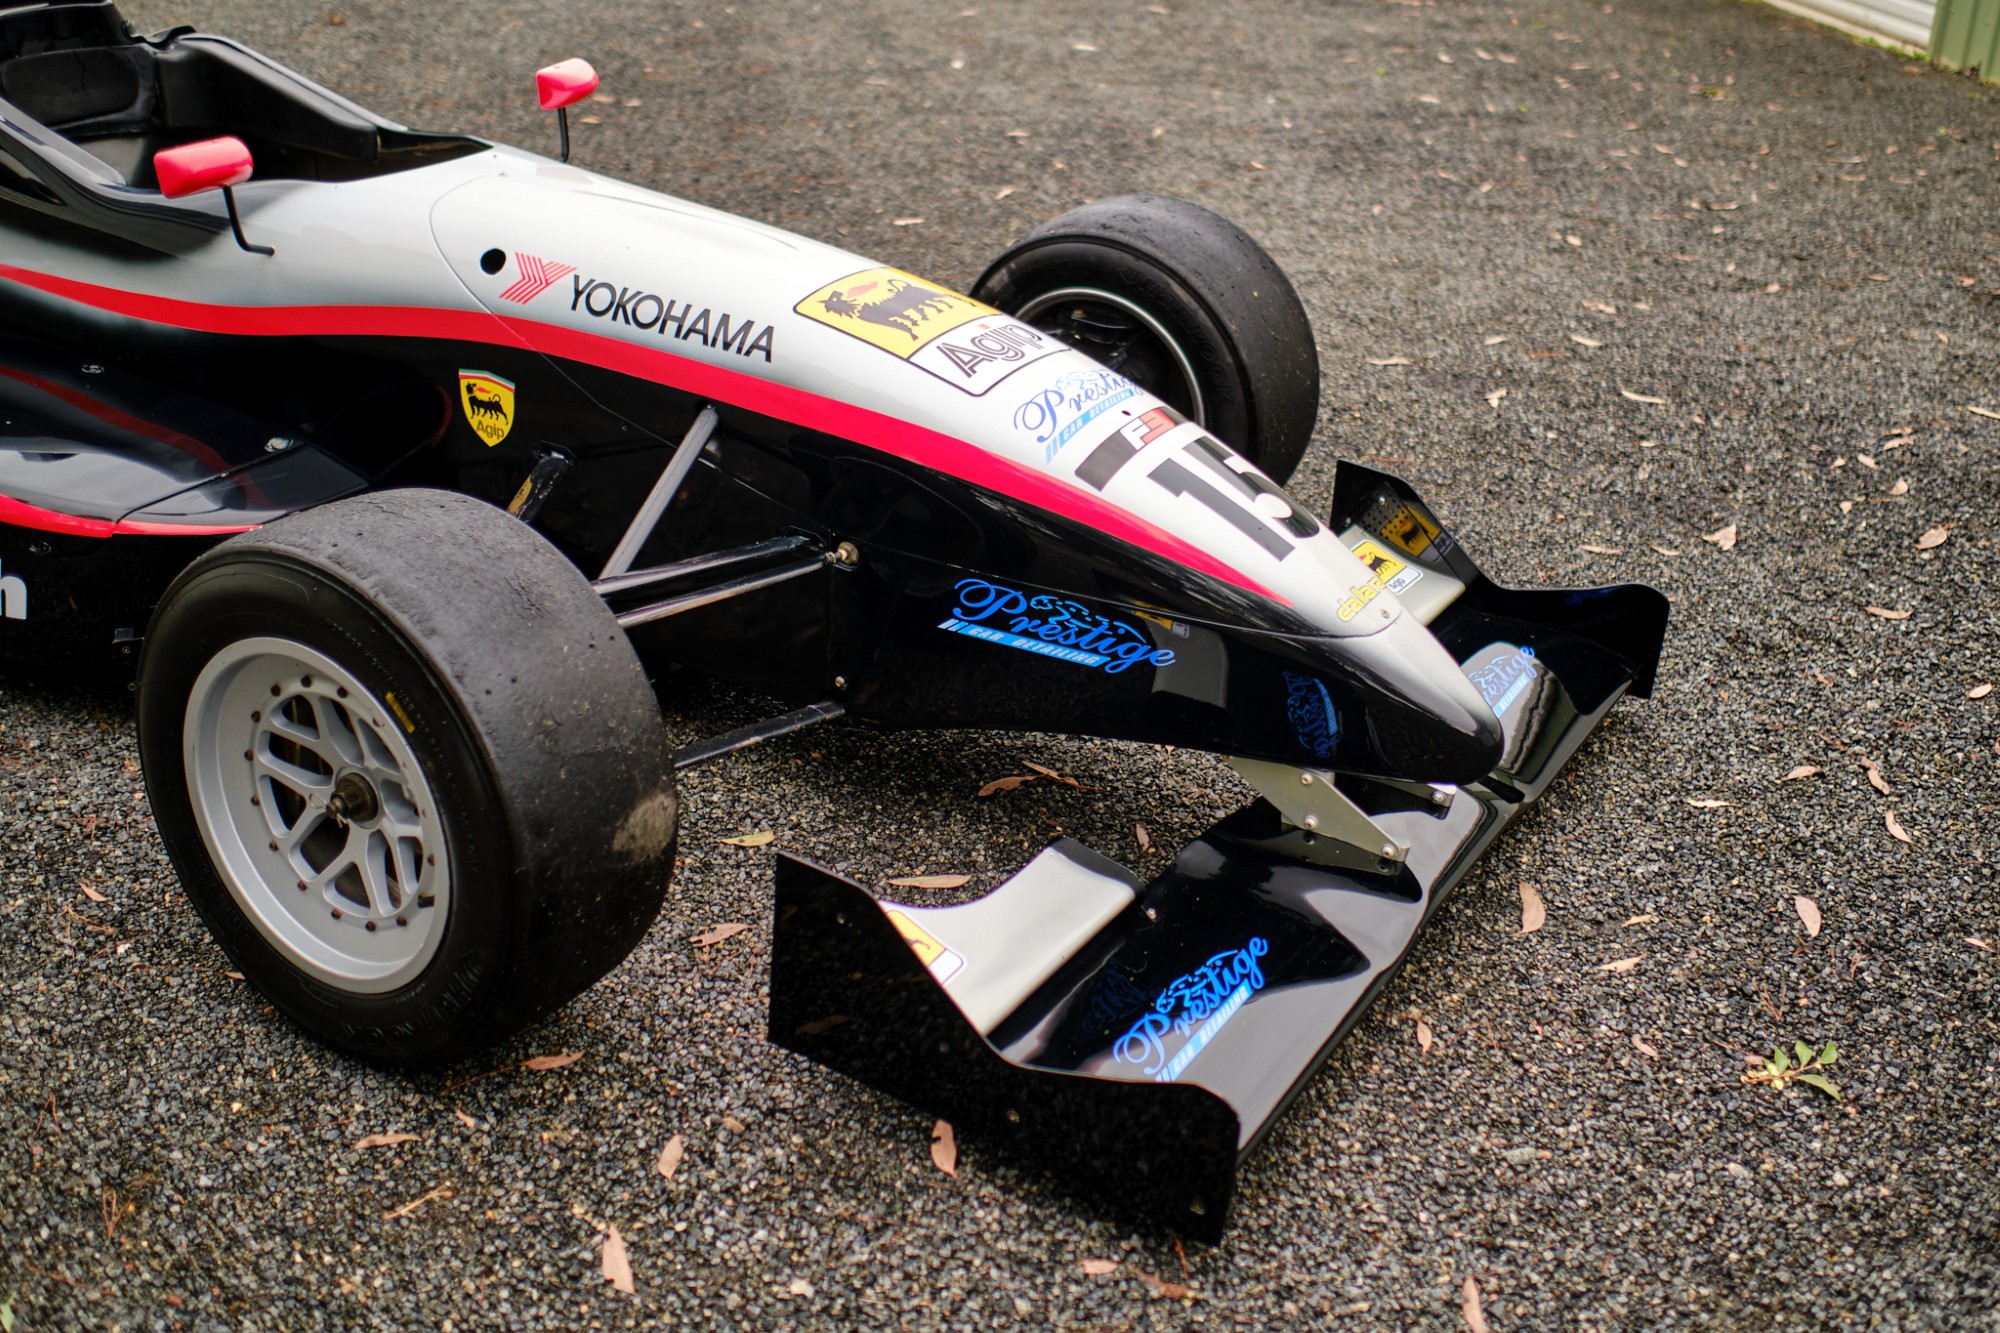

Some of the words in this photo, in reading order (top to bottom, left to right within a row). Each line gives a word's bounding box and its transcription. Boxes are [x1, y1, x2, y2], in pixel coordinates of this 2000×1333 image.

[571, 274, 774, 363] YOKOHAMA
[936, 324, 1045, 378] Agip
[476, 420, 505, 440] Agip
[1013, 372, 1144, 443] Prestig
[1062, 419, 1083, 440] CAR
[1089, 389, 1132, 418] DETAILING
[1120, 407, 1176, 451] F3
[1146, 435, 1320, 562] 15
[953, 578, 1176, 674] Prestige
[967, 627, 1005, 641] CAR
[1011, 639, 1101, 665] DETAILING
[1482, 645, 1537, 705] restige
[1113, 936, 1269, 1076] Prestige
[1173, 1044, 1194, 1073] CAR
[1199, 984, 1247, 1045] DETAILING
